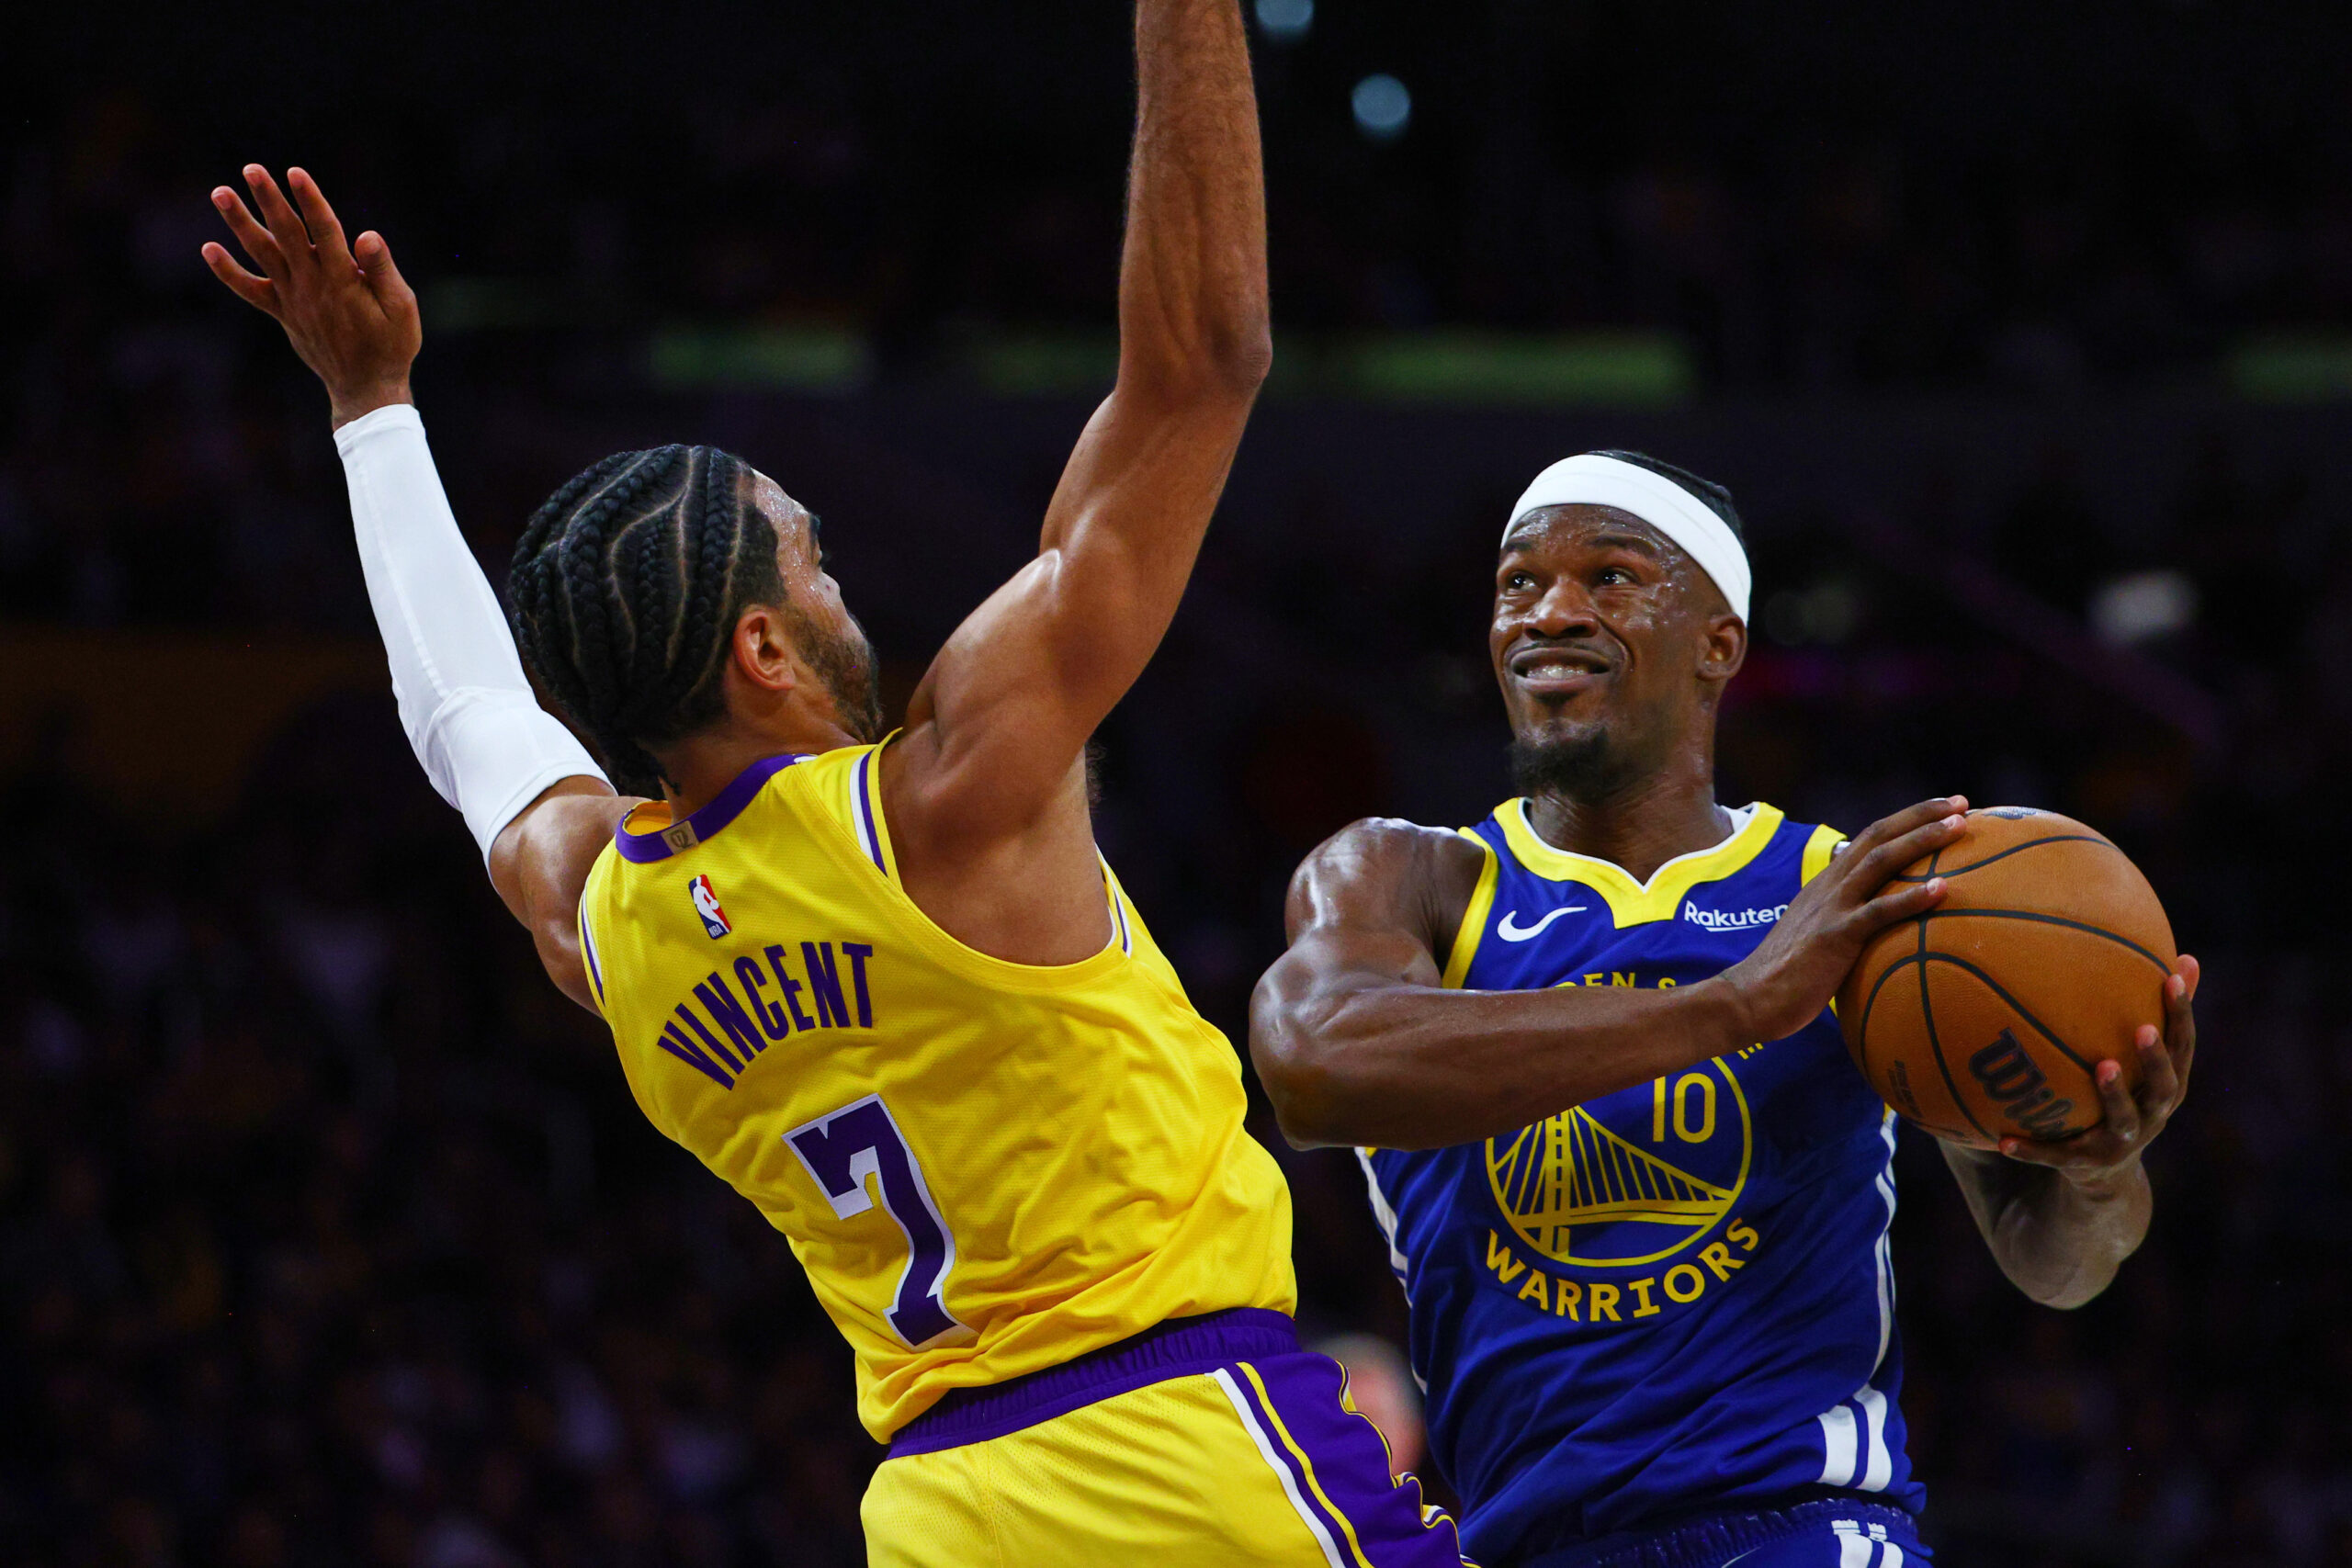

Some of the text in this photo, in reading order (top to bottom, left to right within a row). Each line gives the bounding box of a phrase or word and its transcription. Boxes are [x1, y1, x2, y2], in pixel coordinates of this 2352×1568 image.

[707, 923, 724, 938] NBA
[657, 941, 874, 1090] VINCENT
[1653, 1072, 1716, 1144] 10
[782, 1093, 980, 1352] 7
[1484, 1217, 1759, 1322] WARRIORS
